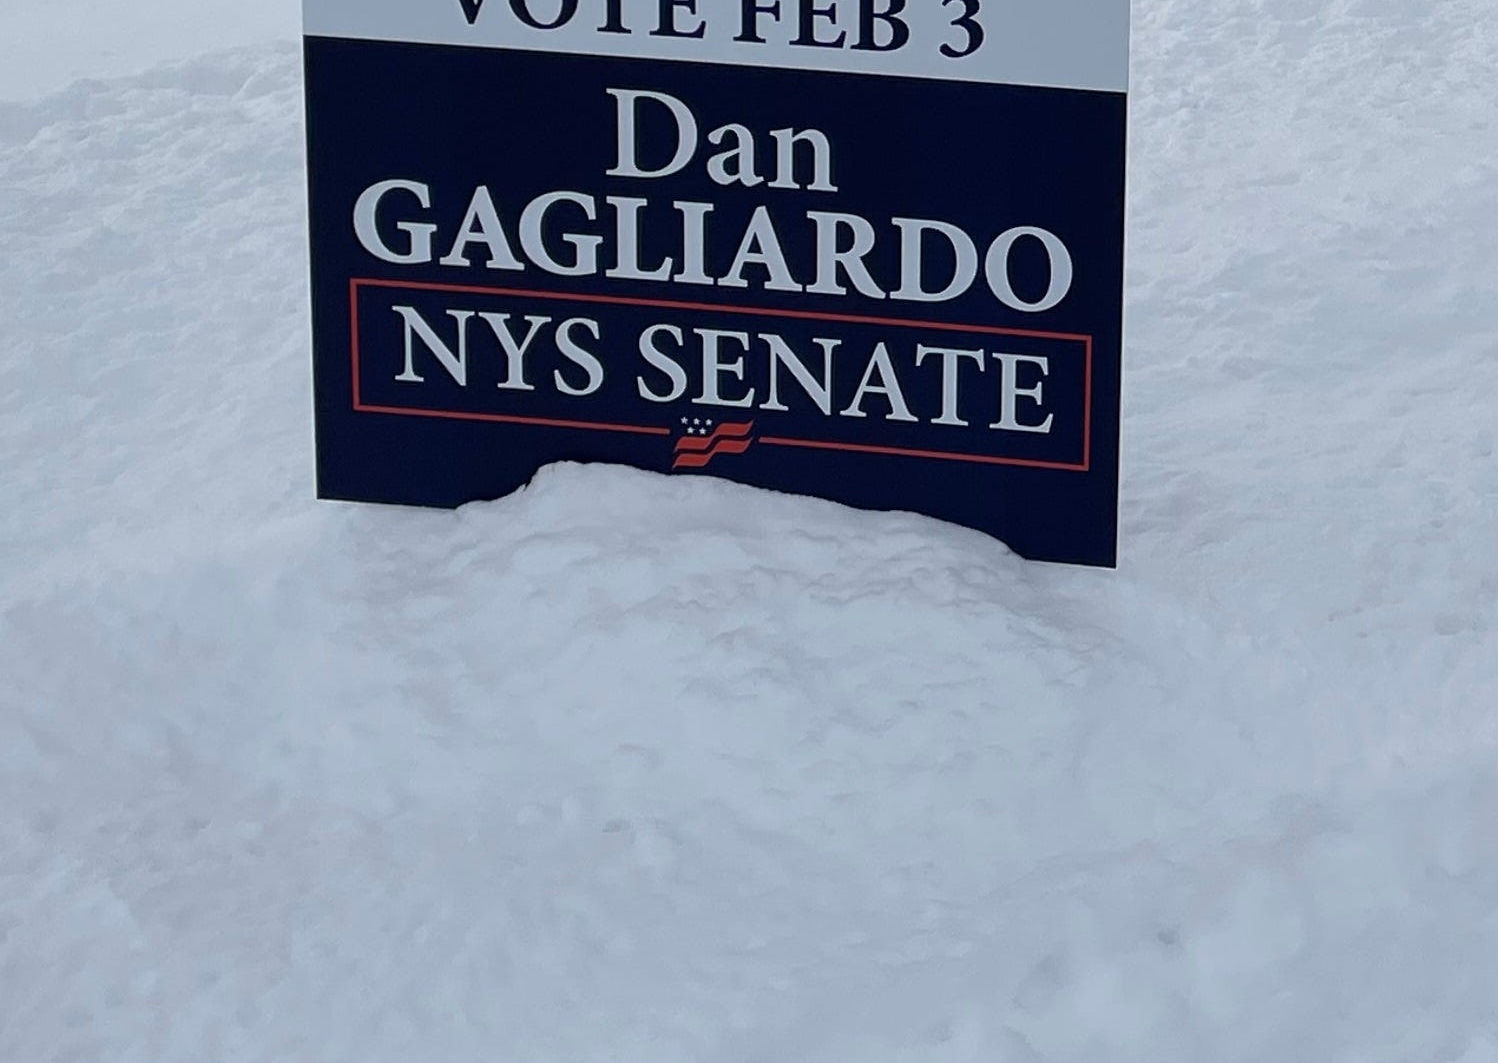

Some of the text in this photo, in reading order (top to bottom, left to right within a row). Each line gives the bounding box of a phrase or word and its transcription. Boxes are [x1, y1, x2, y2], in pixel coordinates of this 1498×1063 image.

[605, 87, 839, 193] Dan
[353, 179, 1073, 312] GAGLIARDO
[391, 305, 1055, 434] NYS SENATE
